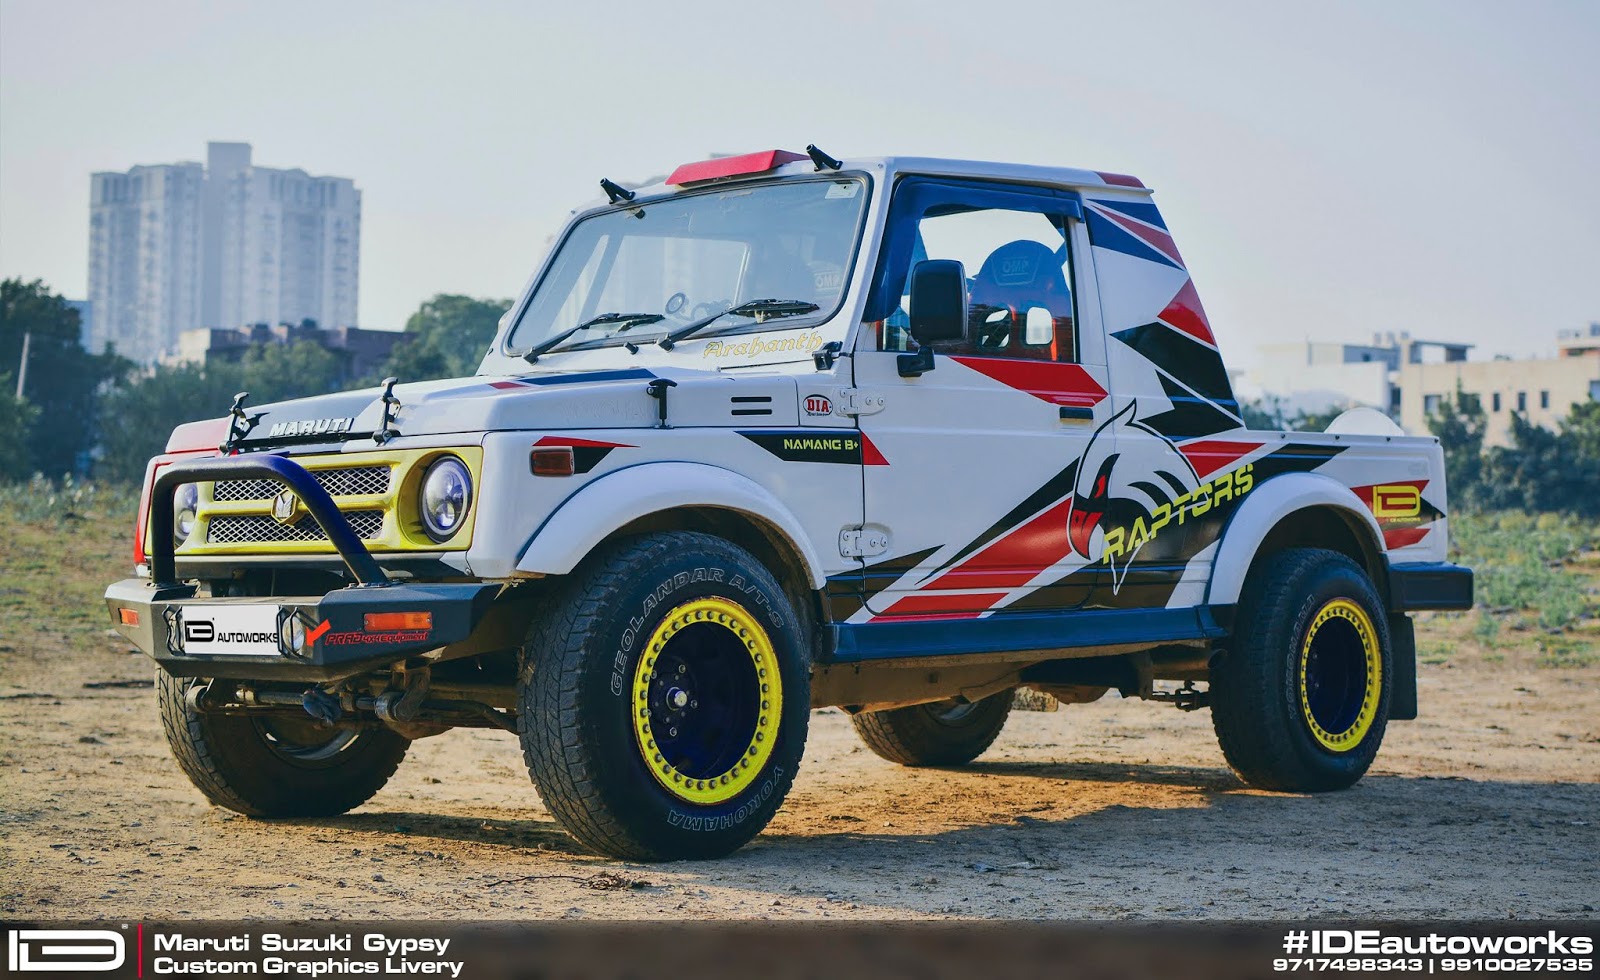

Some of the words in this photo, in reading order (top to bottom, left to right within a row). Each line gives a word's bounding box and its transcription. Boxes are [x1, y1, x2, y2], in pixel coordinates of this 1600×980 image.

[703, 331, 823, 358] Arahanth
[807, 398, 829, 412] DIA
[269, 418, 355, 437] MARUTI
[783, 439, 842, 450] NAWANG
[1103, 463, 1254, 565] RAPTORS
[217, 632, 280, 643] AUTOWORKS
[611, 567, 725, 696] GEOLANDAR
[667, 766, 784, 832] YOKOHAMA
